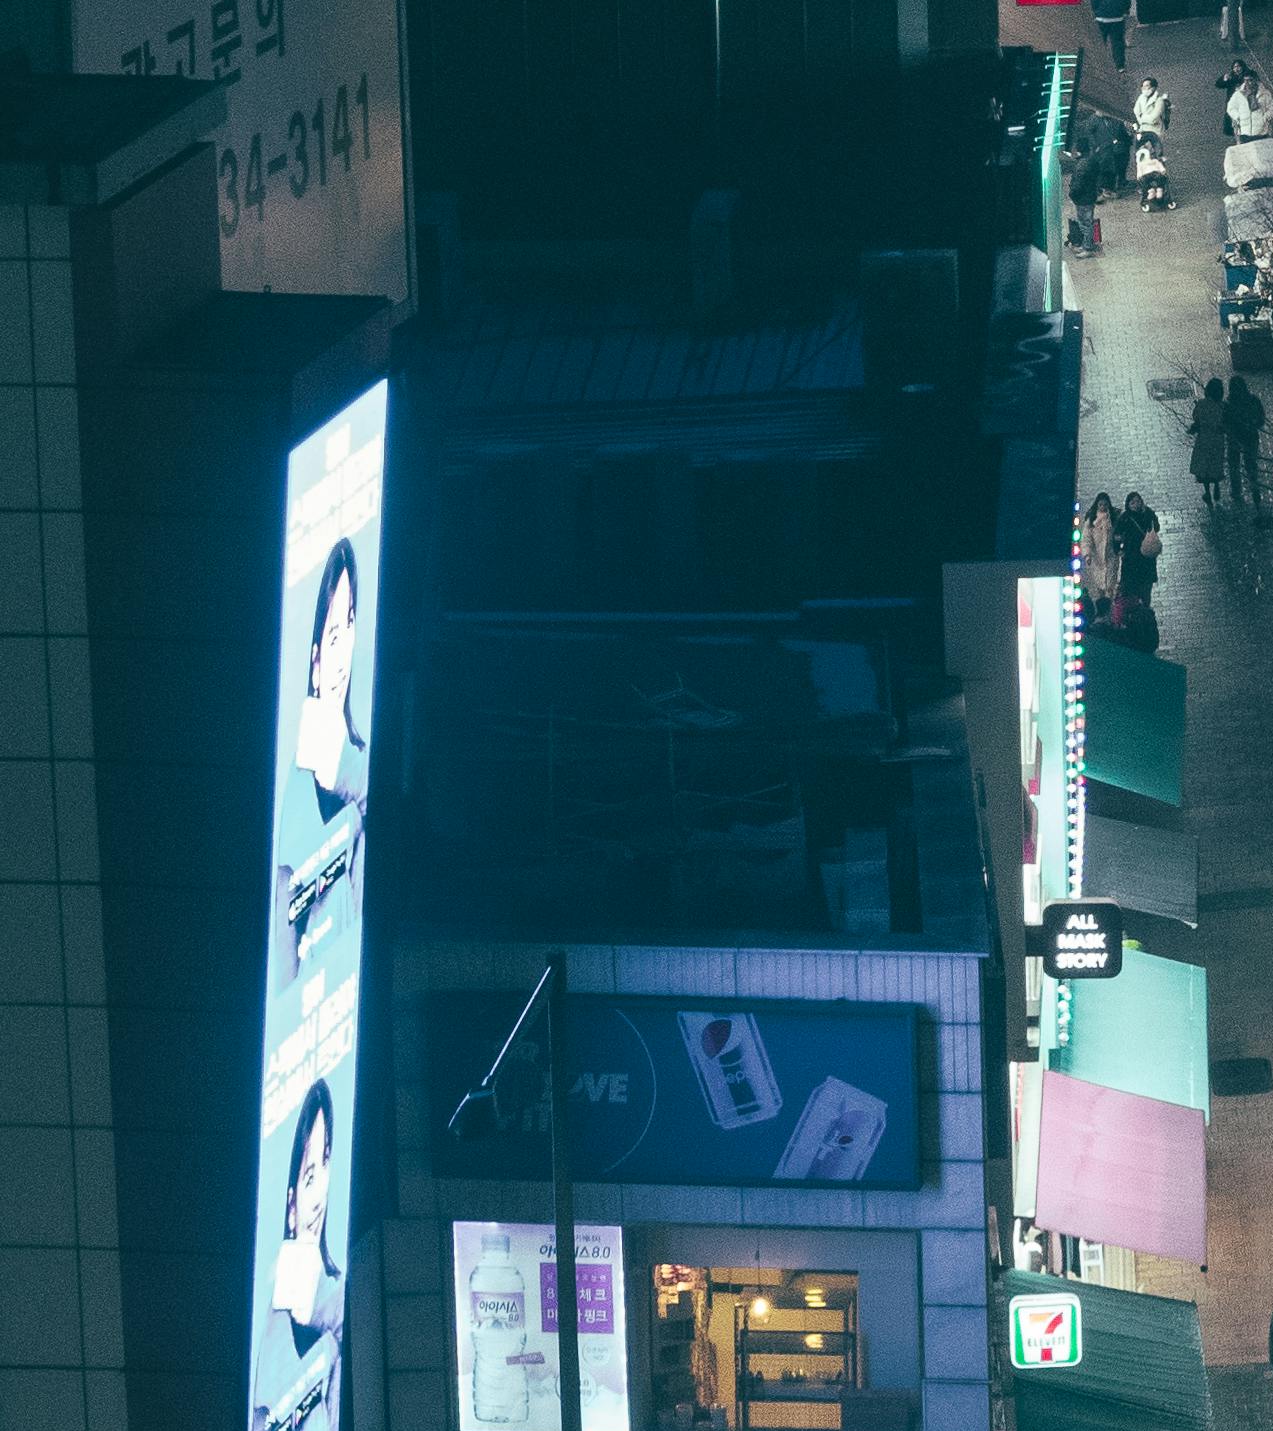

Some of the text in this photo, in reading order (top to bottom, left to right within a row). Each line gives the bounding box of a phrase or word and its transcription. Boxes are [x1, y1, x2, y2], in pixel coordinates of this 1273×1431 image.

[1066, 914, 1099, 930] ALL
[1056, 932, 1107, 949] MASK
[1055, 952, 1109, 969] STORY
